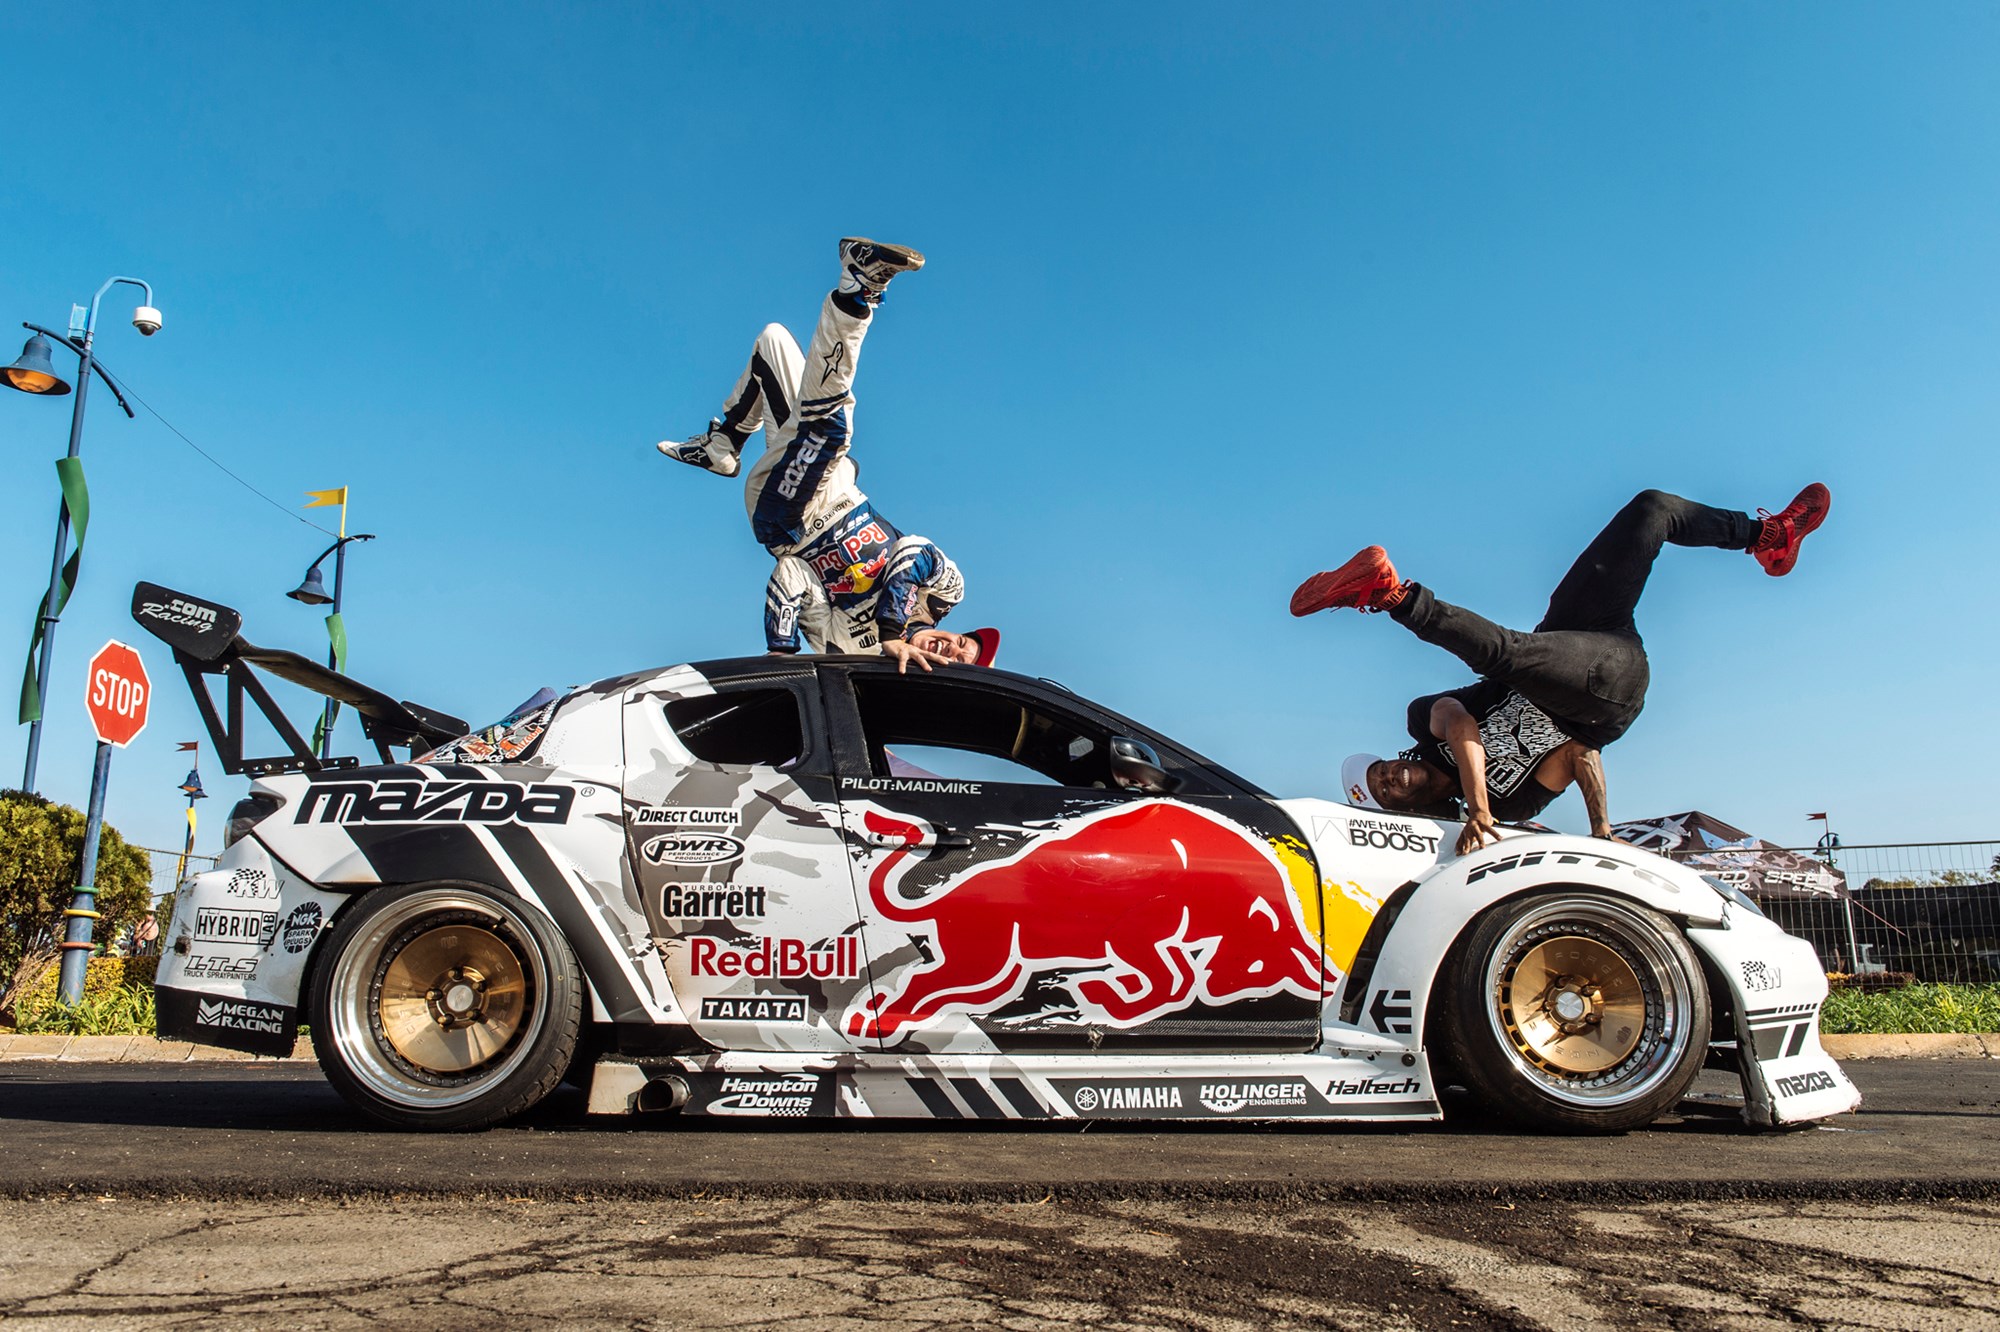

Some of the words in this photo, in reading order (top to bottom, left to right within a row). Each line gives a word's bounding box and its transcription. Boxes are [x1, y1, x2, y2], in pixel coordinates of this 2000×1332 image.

[844, 522, 888, 562] Red
[140, 601, 214, 633] Racing
[93, 668, 144, 719] STOP
[841, 777, 982, 795] PILOT:MADMIKE
[294, 782, 576, 825] mazda
[638, 809, 687, 823] DIRECT
[689, 810, 738, 824] CLUTCH
[1348, 819, 1378, 831] #WE
[1378, 822, 1413, 834] HAVE
[1350, 830, 1439, 855] BOOST
[235, 879, 285, 899] KW
[663, 885, 766, 918] Garrett
[291, 911, 319, 927] NGK
[197, 915, 260, 938] HYBRID
[261, 914, 276, 945] LAB
[287, 929, 312, 938] SPARK
[285, 937, 309, 946] PLUGS
[691, 937, 771, 976] Red
[780, 937, 857, 977] Bull
[183, 969, 204, 978] TRUCK
[207, 971, 257, 981] SPRAYPAINTERS
[1753, 966, 1782, 992] KW
[223, 1002, 284, 1022] MEGAN
[705, 1001, 803, 1019] TAKATA
[222, 1015, 283, 1034] RACING
[720, 1077, 819, 1096] Hampton
[1199, 1083, 1307, 1101] HOLINGER
[1325, 1077, 1421, 1096] Haltech
[1775, 1070, 1836, 1098] mazda
[738, 1093, 813, 1108] Downs
[1099, 1086, 1183, 1109] YAMAHA
[1248, 1098, 1307, 1106] ENGINEERING
